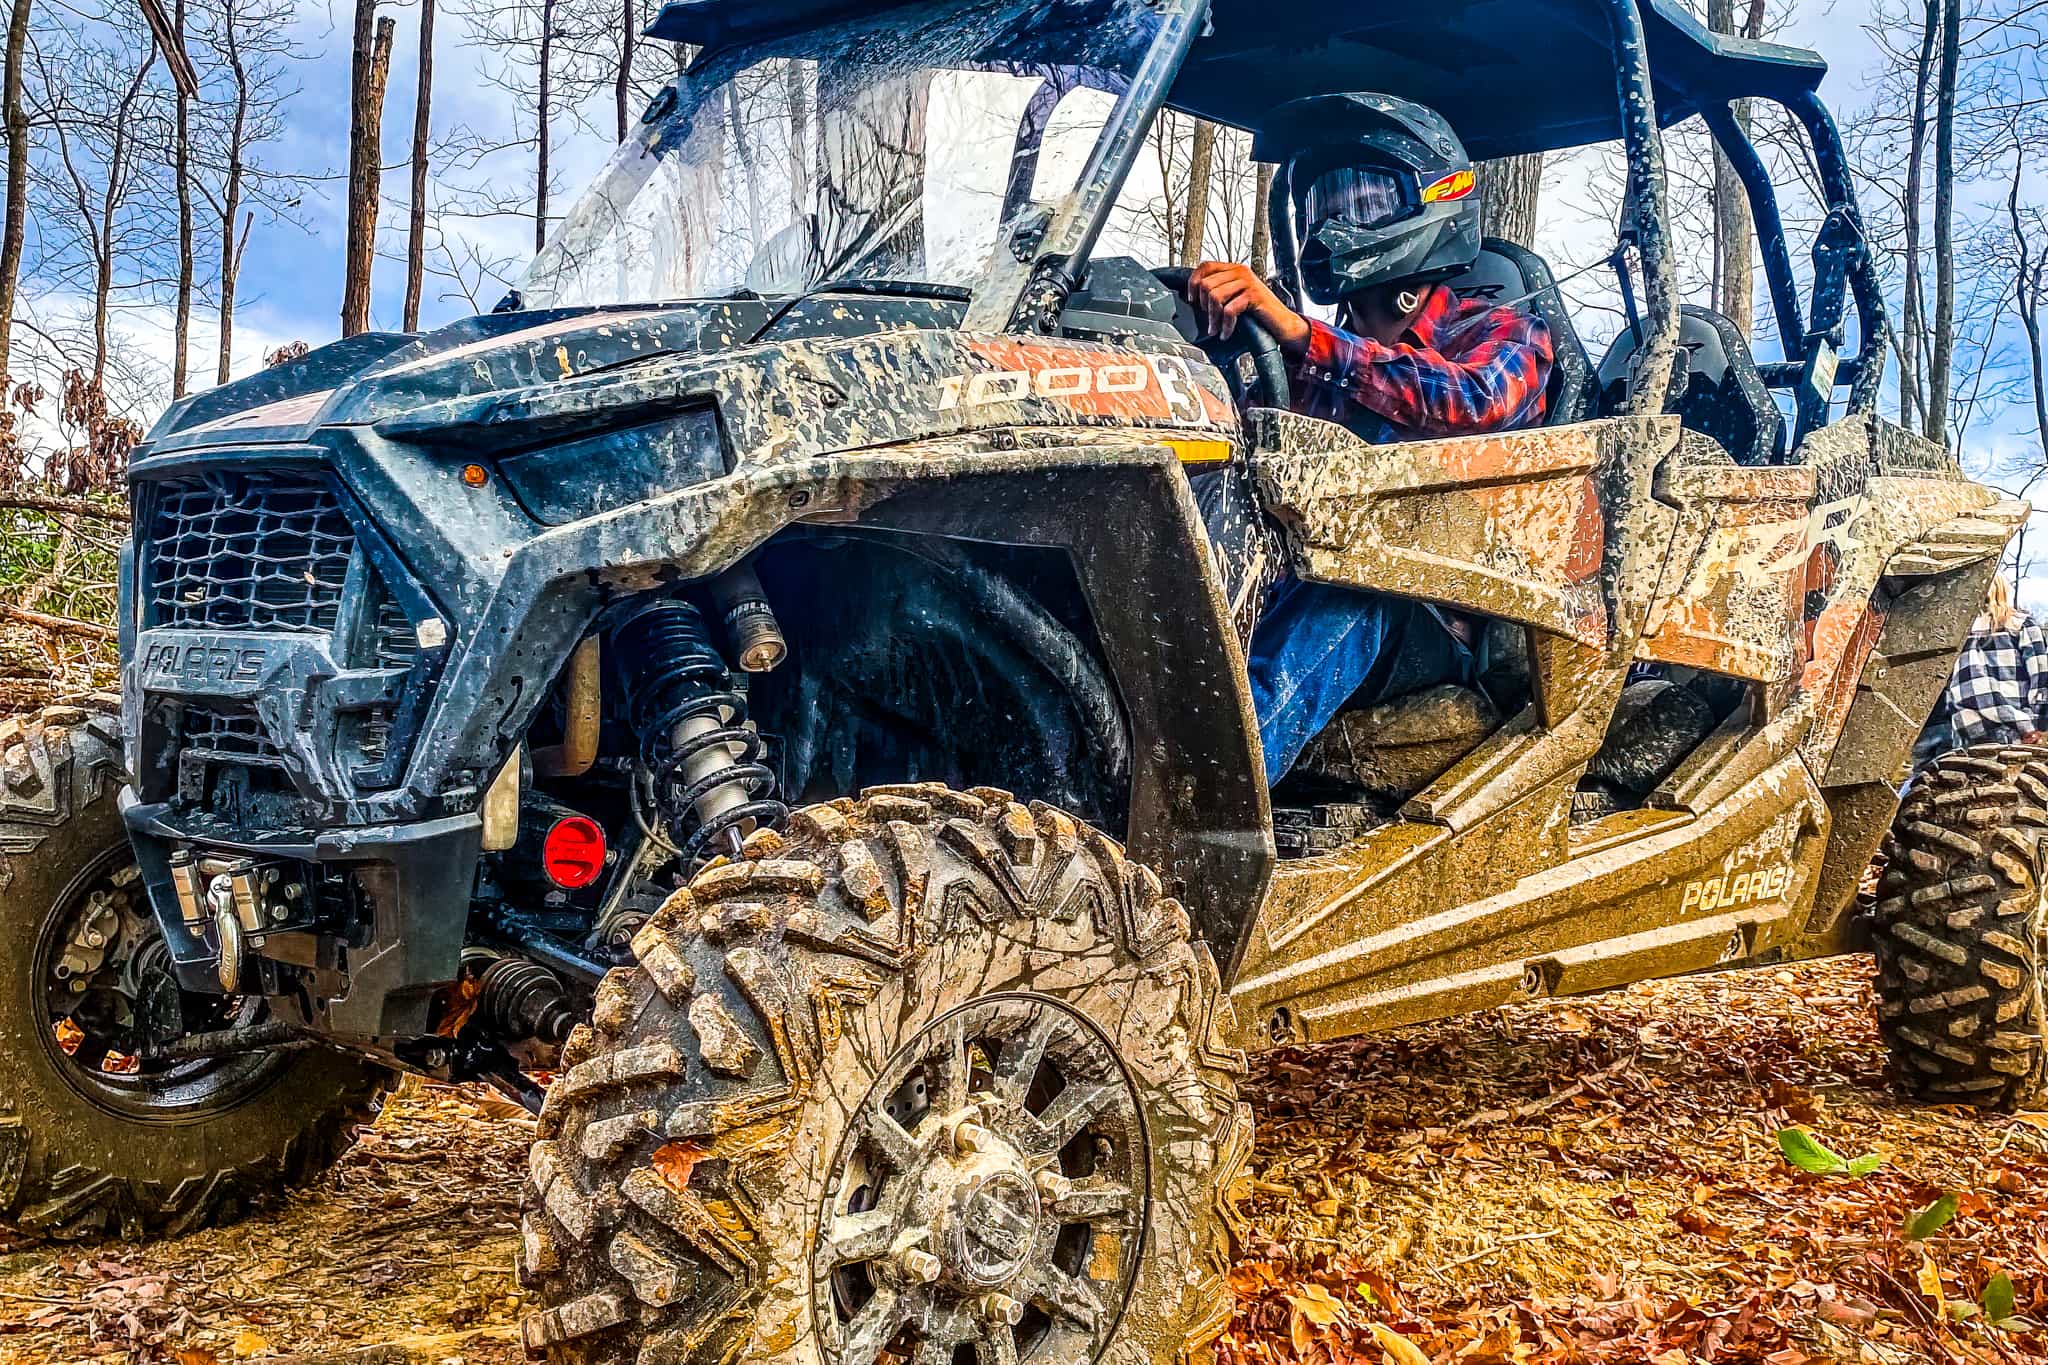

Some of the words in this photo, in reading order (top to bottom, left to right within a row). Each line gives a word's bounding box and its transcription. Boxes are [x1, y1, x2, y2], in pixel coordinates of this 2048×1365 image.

[935, 363, 1149, 411] 1000
[143, 644, 267, 684] POLARIS
[1679, 864, 1787, 915] POLARIS
